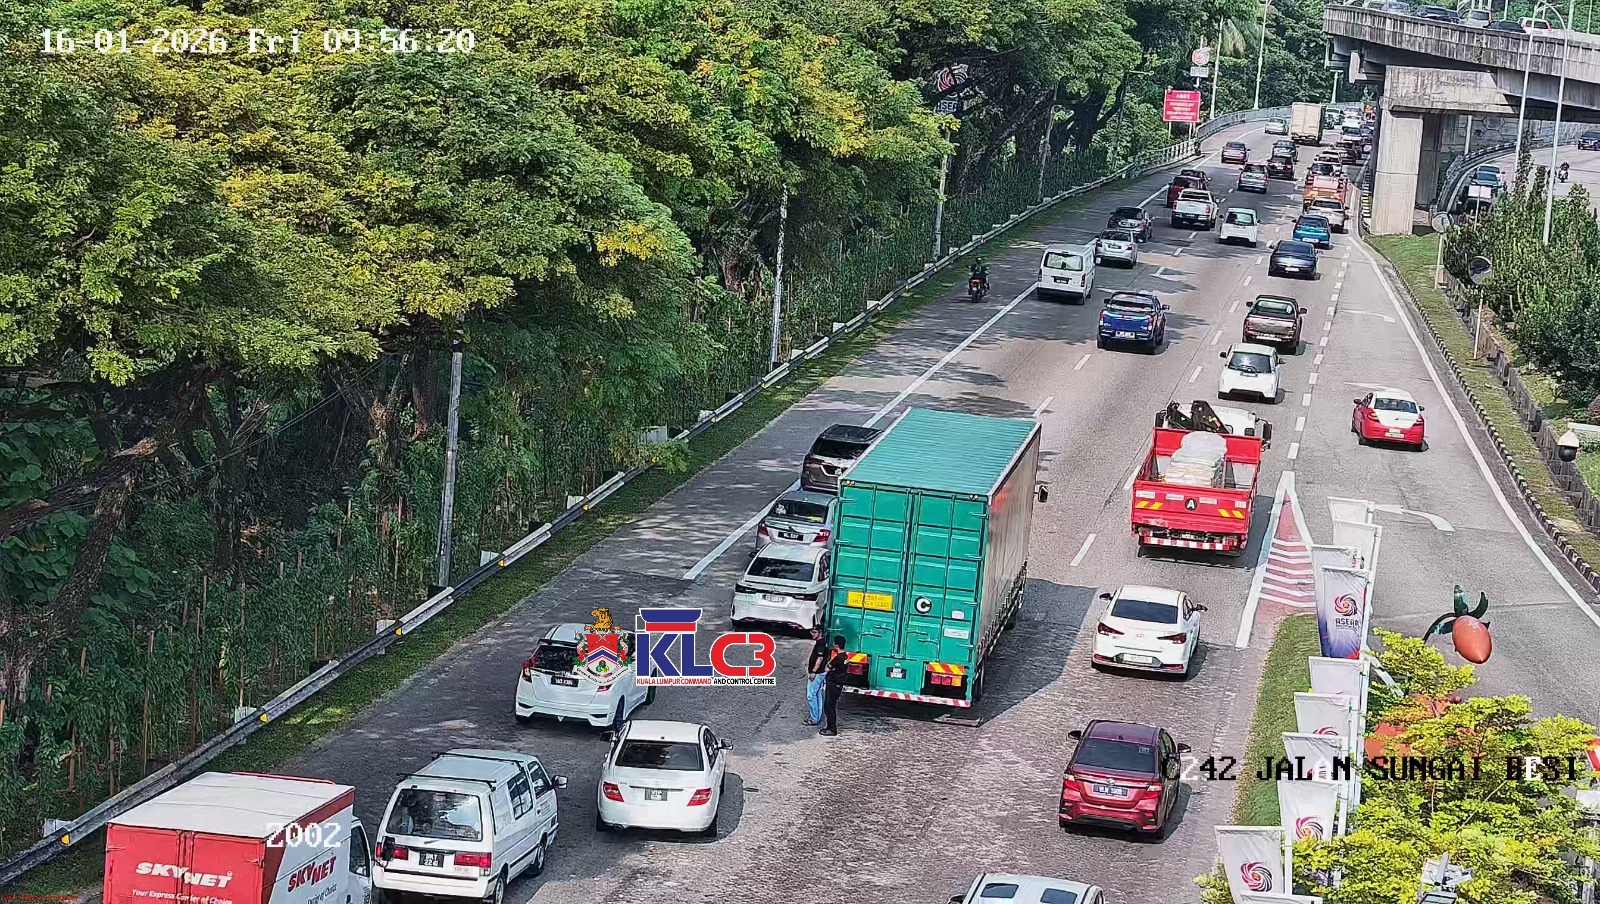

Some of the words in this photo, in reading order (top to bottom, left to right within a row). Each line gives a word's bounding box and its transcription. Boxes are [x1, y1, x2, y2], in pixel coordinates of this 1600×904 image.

[1186, 499, 1196, 510] A
[916, 597, 932, 613] C
[136, 862, 232, 888] SKYNET
[288, 856, 337, 892] SKYNET
[132, 888, 148, 897] Your
